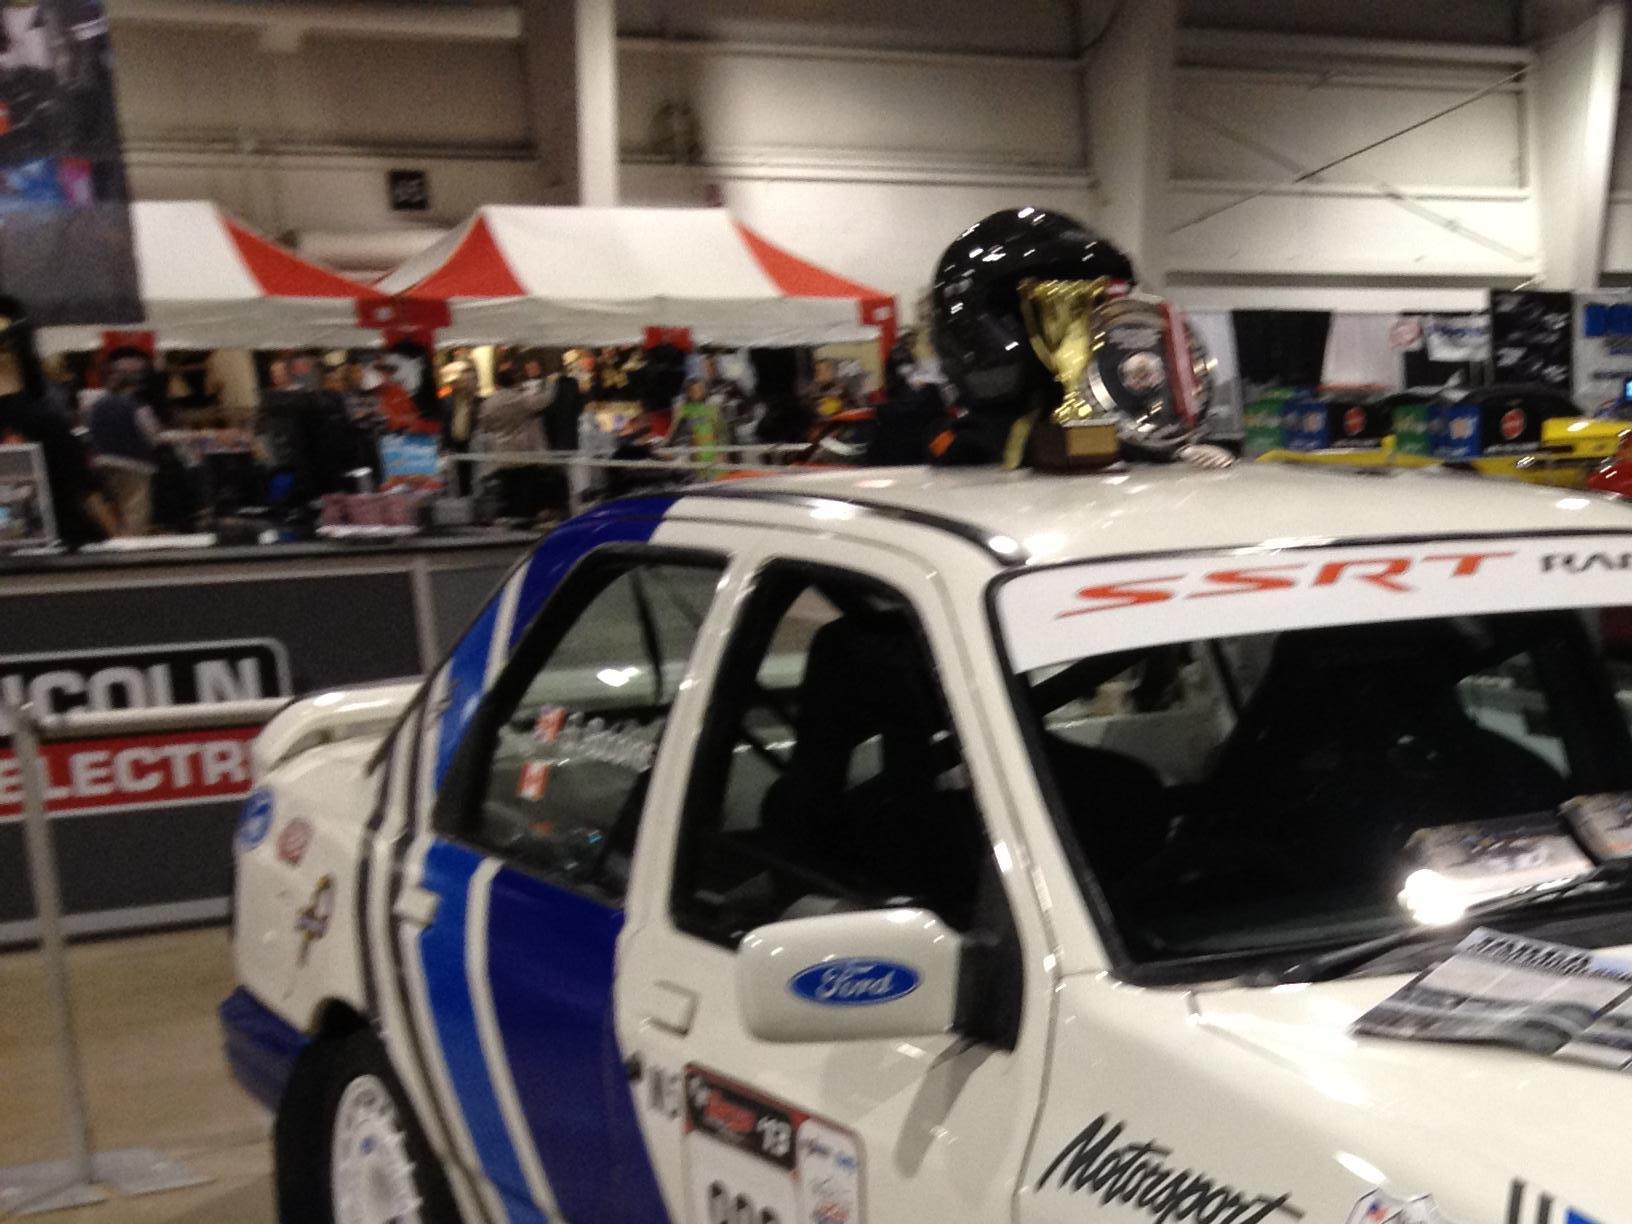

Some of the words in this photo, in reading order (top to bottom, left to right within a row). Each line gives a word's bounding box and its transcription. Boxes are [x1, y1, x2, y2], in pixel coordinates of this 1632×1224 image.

[1054, 551, 1518, 620] SSRT
[0, 738, 252, 805] ELECTR
[815, 959, 897, 1000] Ford
